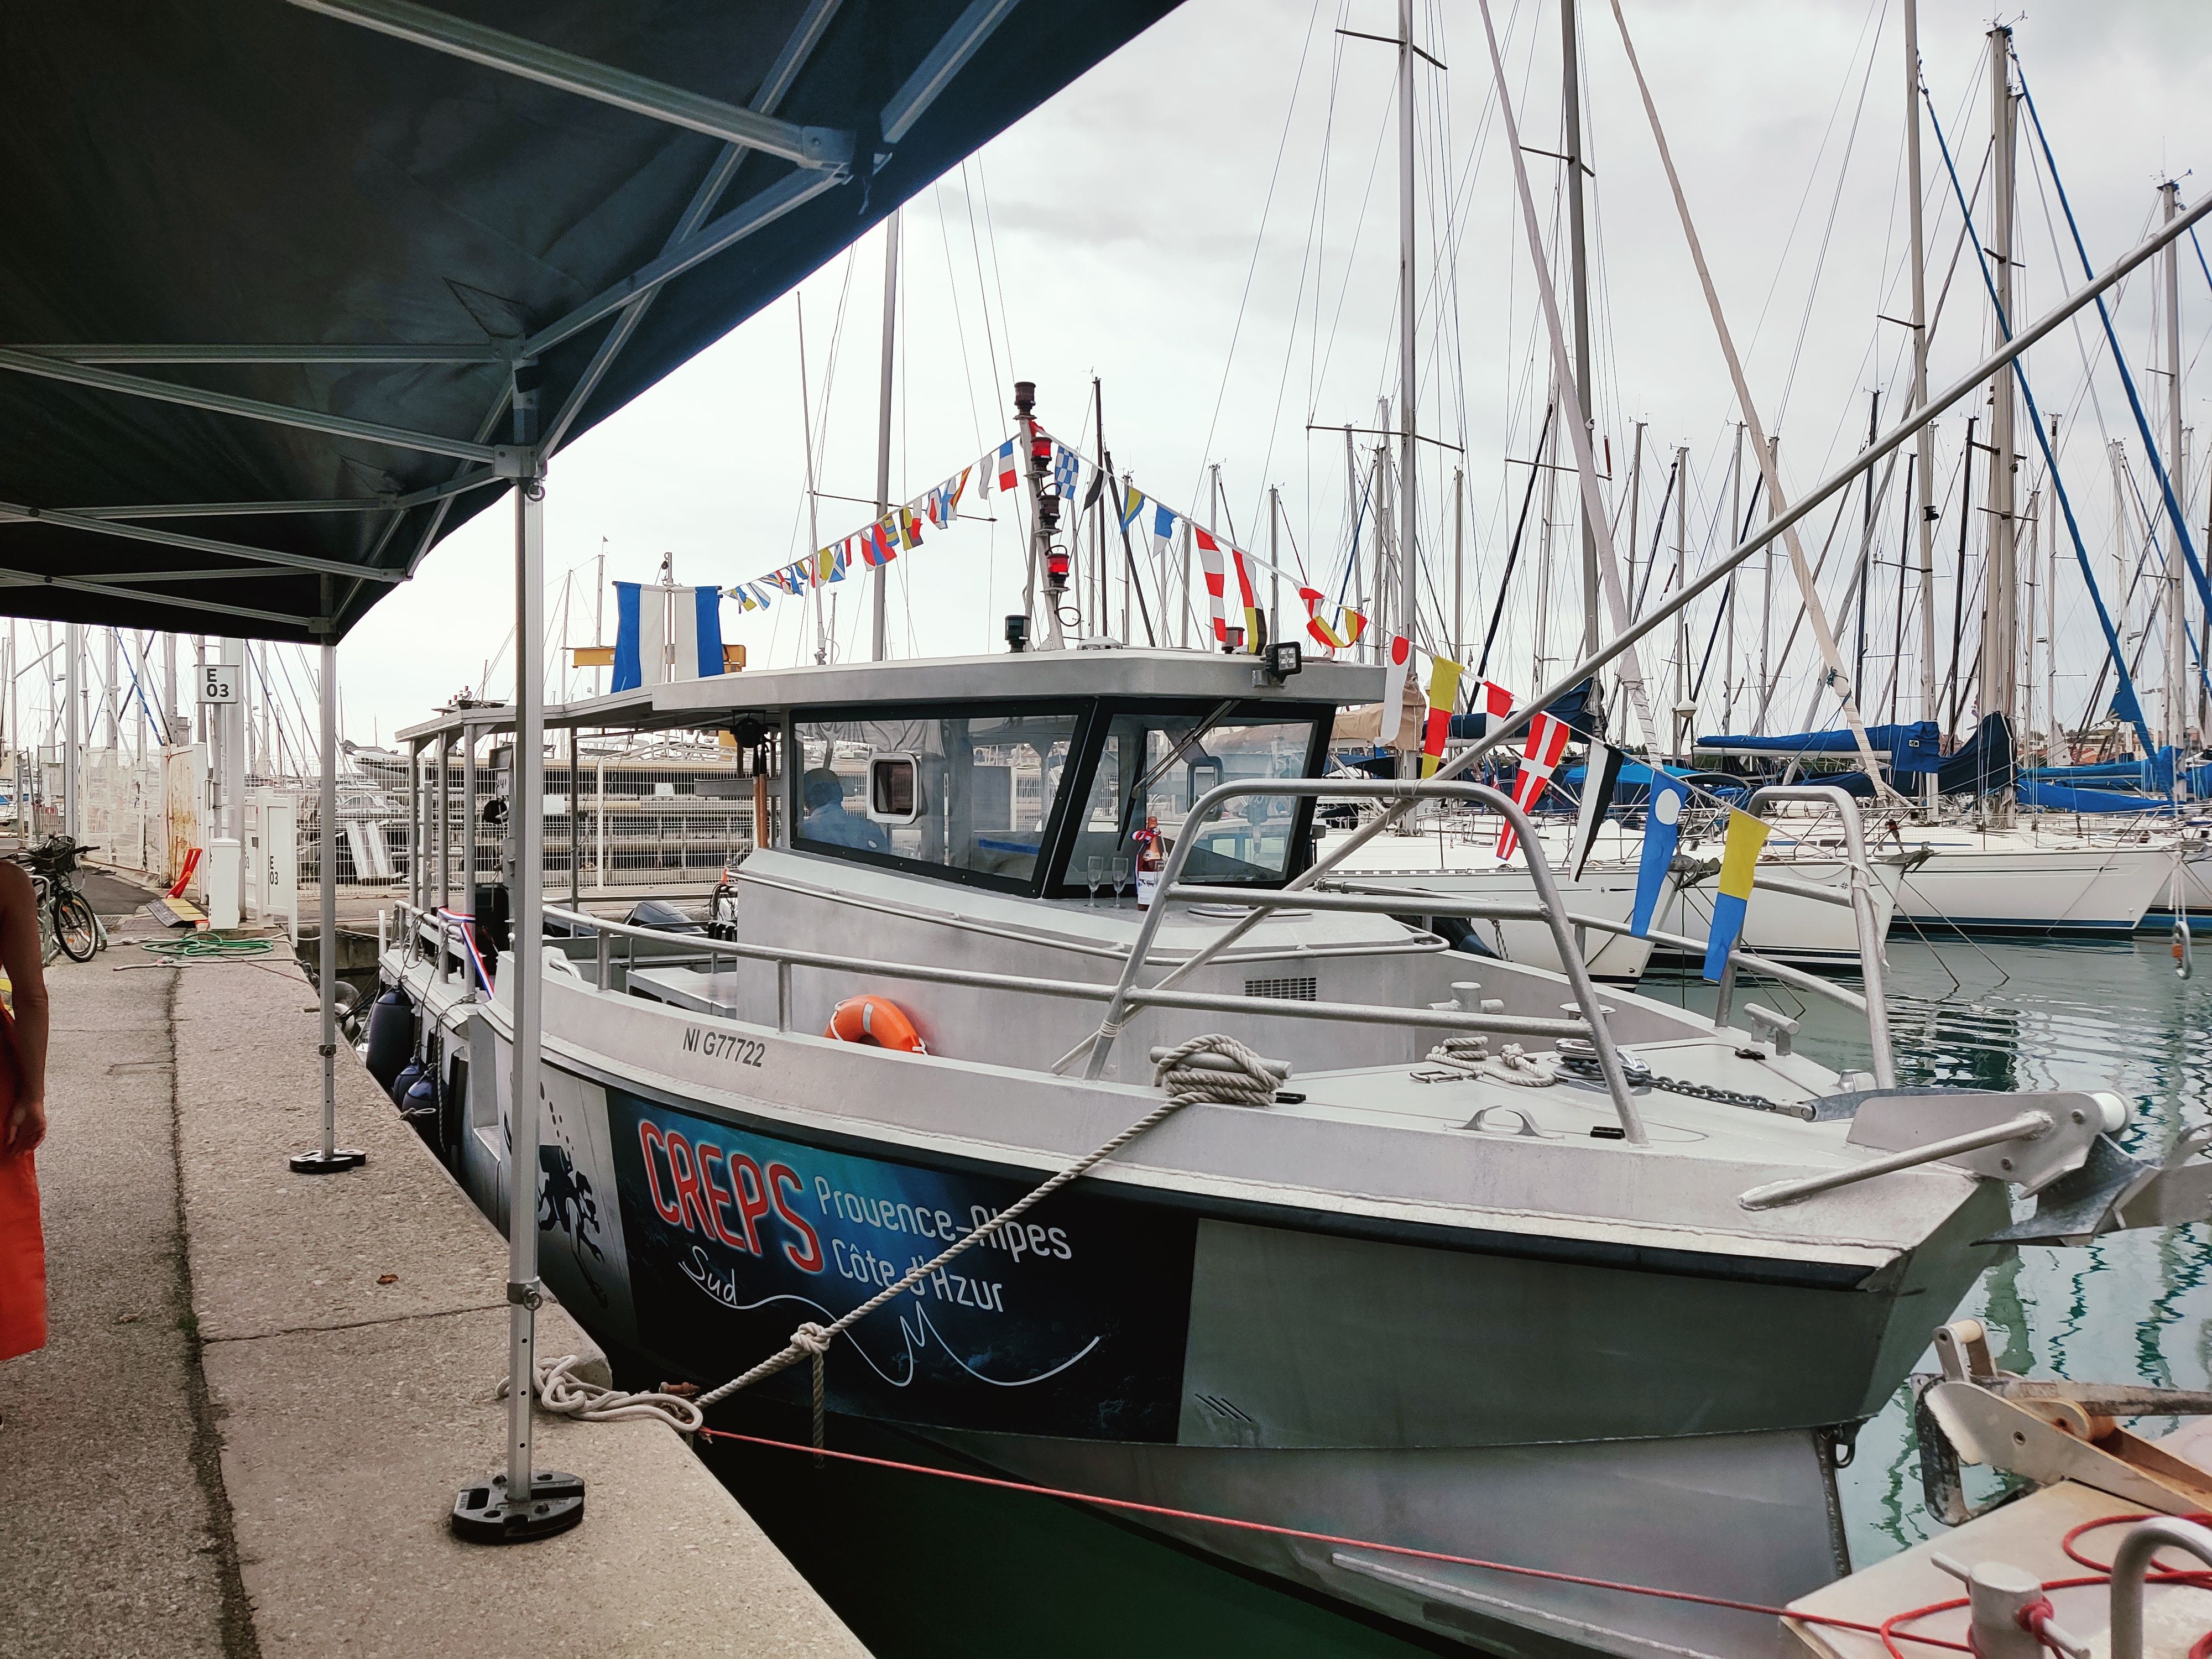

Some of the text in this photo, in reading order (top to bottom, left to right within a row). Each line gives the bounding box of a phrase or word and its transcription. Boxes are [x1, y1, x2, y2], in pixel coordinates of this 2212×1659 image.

[207, 668, 217, 682] E
[206, 683, 229, 697] 03
[270, 855, 274, 869] E
[269, 871, 278, 885] 03
[683, 1027, 765, 1068] NI G77722
[639, 1121, 824, 1272] CREPS
[681, 1245, 737, 1306] Sud
[832, 1238, 895, 1288] Côte
